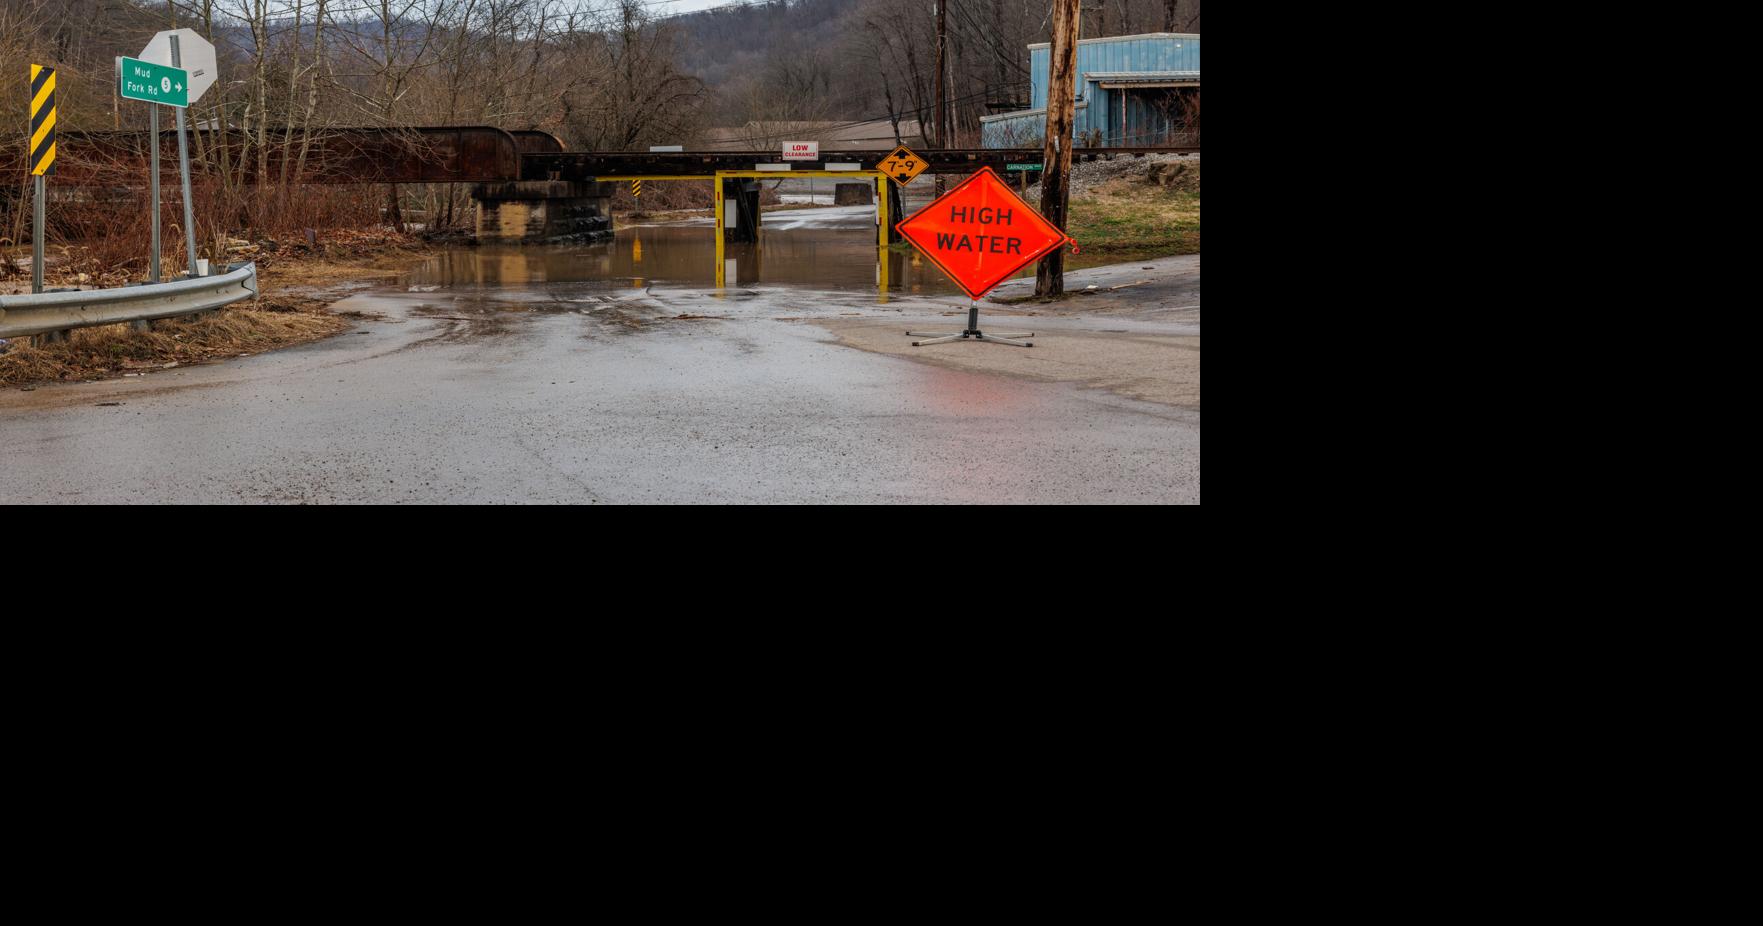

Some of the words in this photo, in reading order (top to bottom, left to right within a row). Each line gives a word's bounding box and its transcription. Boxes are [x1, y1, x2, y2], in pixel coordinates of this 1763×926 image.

[134, 67, 151, 79] Mud
[127, 81, 145, 93] Fork
[147, 85, 158, 96] Rd
[951, 206, 1013, 226] HIGH
[937, 232, 1022, 255] WATER
